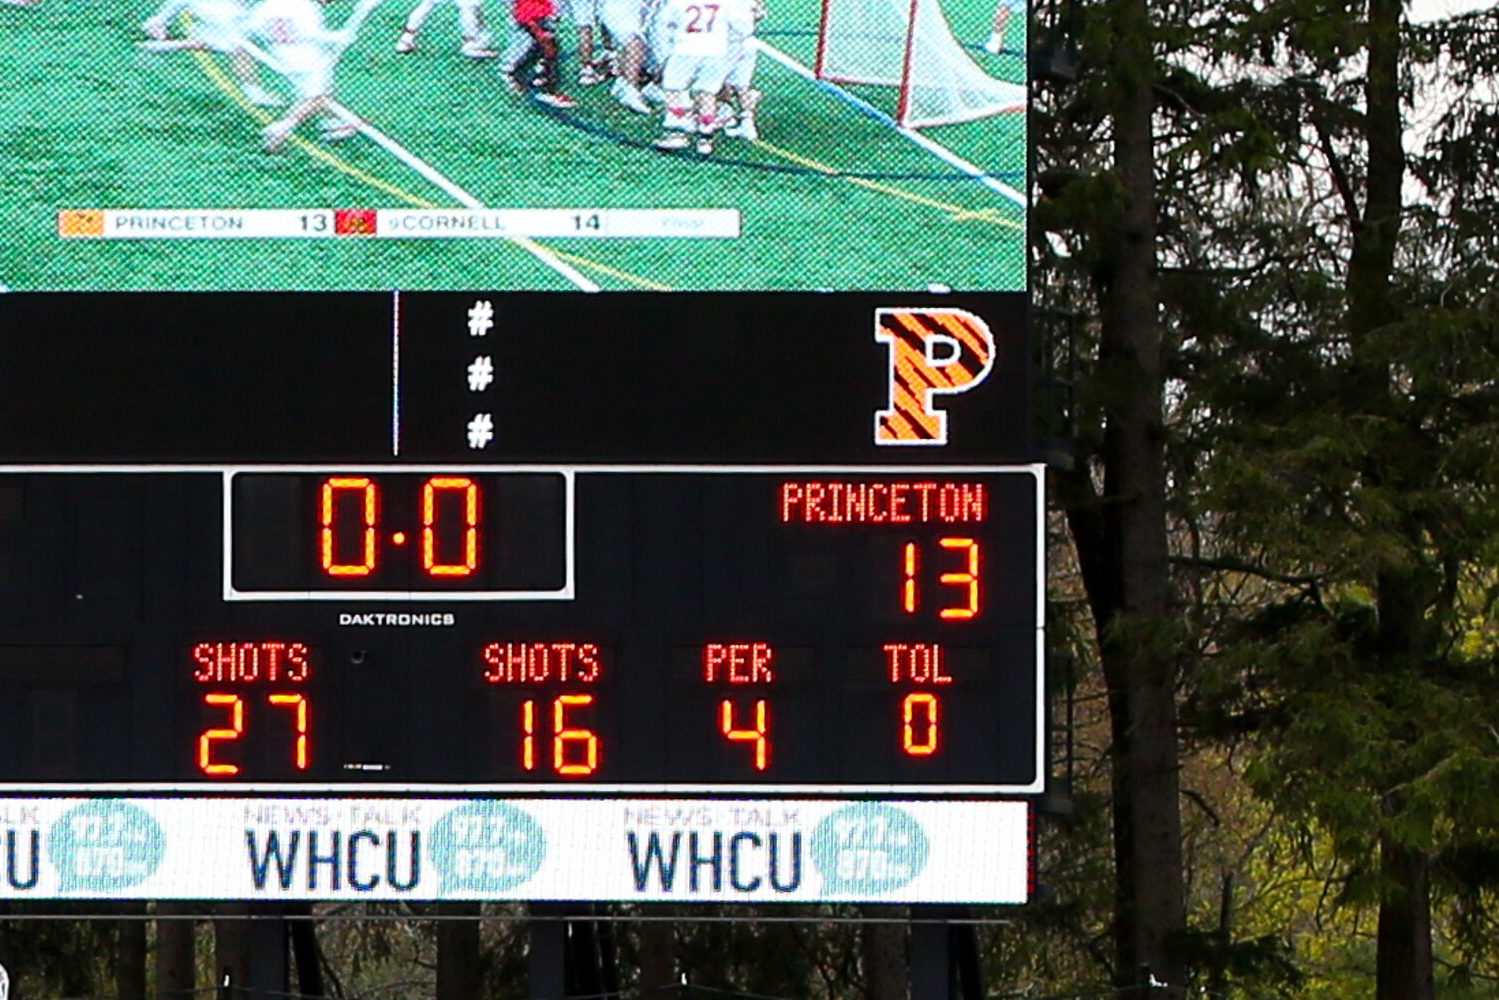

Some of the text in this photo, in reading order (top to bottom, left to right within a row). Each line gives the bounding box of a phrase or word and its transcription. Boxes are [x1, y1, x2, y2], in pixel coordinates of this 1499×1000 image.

[685, 4, 721, 34] 27
[115, 214, 328, 233] PRINCETON 13
[402, 215, 507, 232] CORNELL
[573, 213, 601, 231] 14
[782, 481, 987, 524] PRINCETON
[903, 536, 981, 622] 13
[339, 613, 455, 626] DAKTRONICS
[193, 641, 308, 683] SHOTS
[484, 642, 599, 683] SHOTS
[705, 642, 772, 684] PER
[883, 643, 953, 685] TOL
[196, 692, 311, 777] 27
[522, 693, 602, 778] 16
[720, 699, 772, 771] 4
[901, 691, 942, 757] 0
[246, 829, 420, 892] WHCU
[627, 830, 802, 893] WHCU
